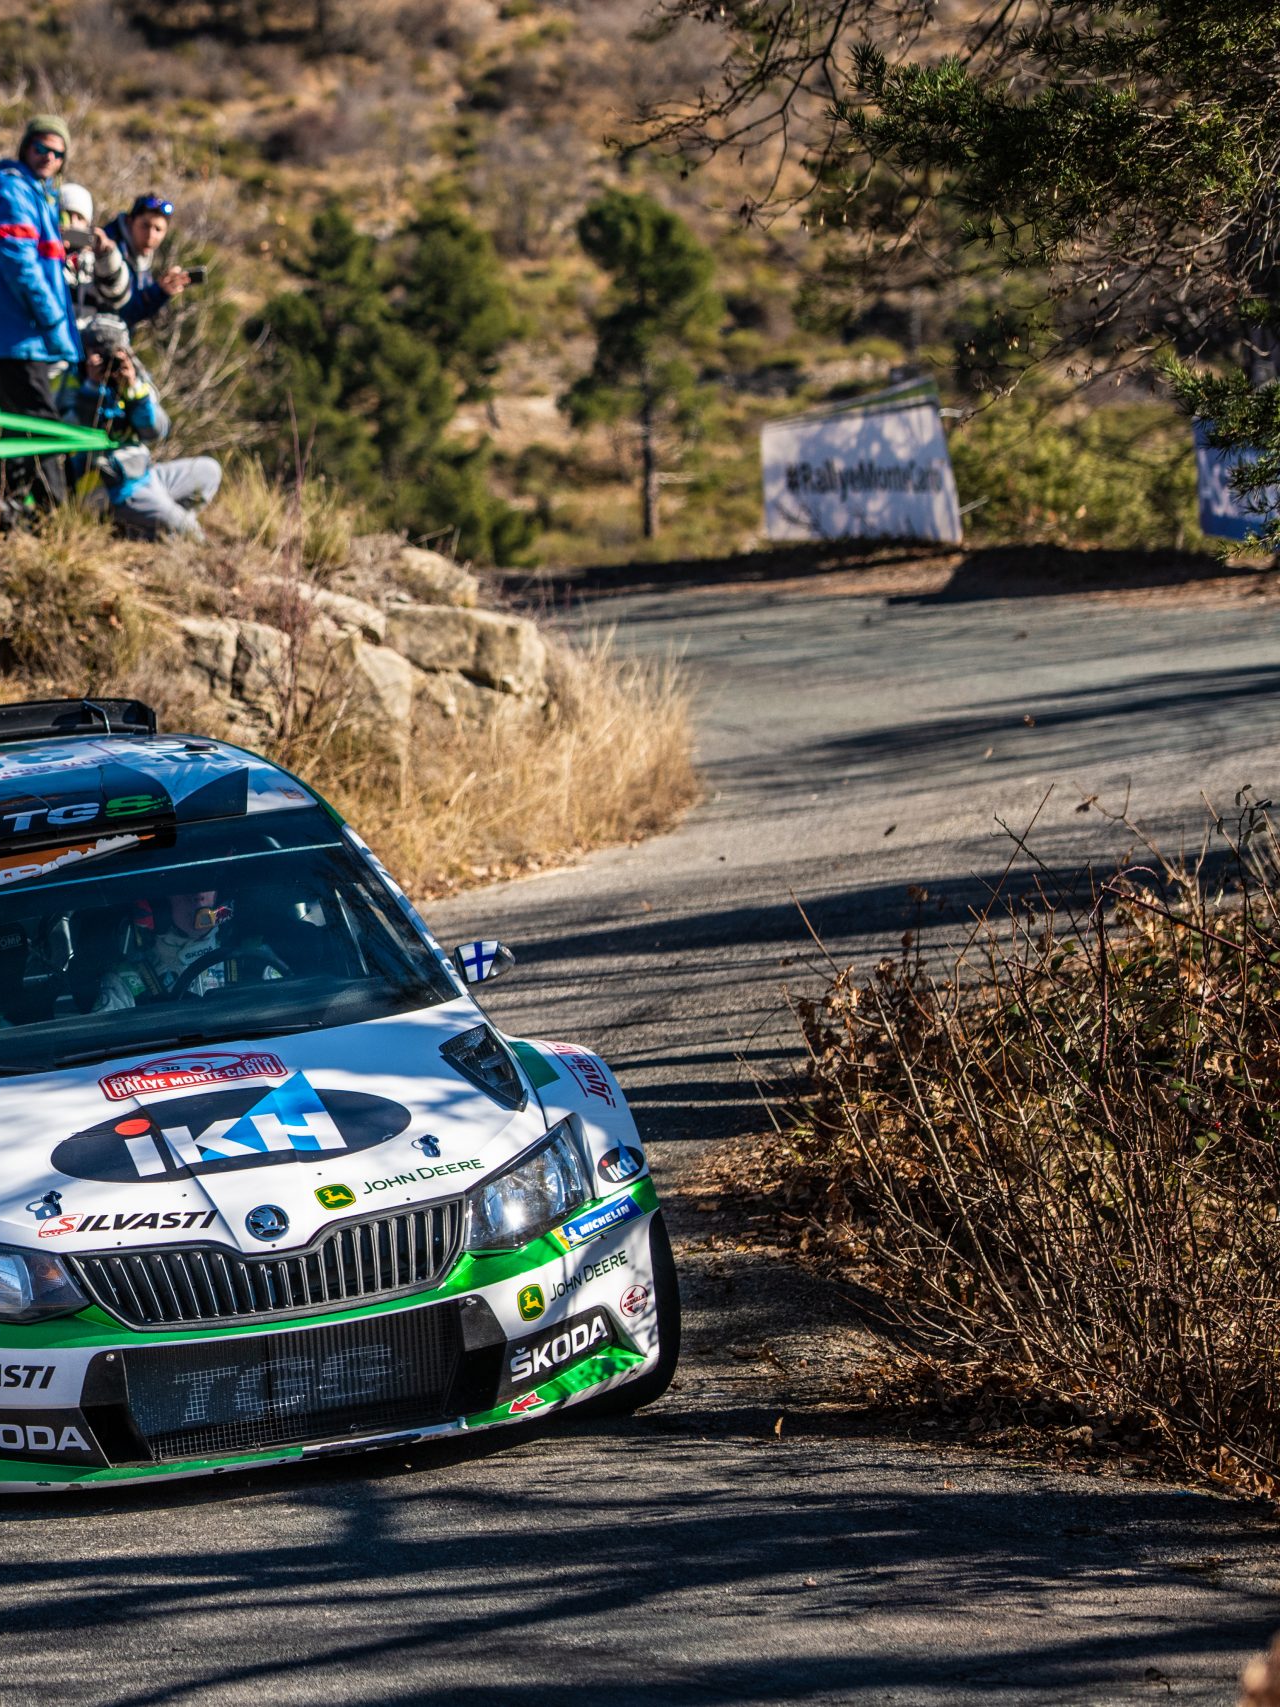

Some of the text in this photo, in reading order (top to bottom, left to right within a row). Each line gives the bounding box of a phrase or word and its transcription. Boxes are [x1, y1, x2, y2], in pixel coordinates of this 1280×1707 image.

[3, 794, 167, 832] TGS
[111, 1060, 278, 1098] RALLYE MONTE-CARLO
[363, 1159, 485, 1194] JOHN DEERE
[38, 1208, 219, 1239] SILVASTI
[579, 1204, 631, 1236] MICHELIN
[550, 1250, 629, 1302] JOHN DEERE
[511, 1316, 609, 1383] ŠKODA
